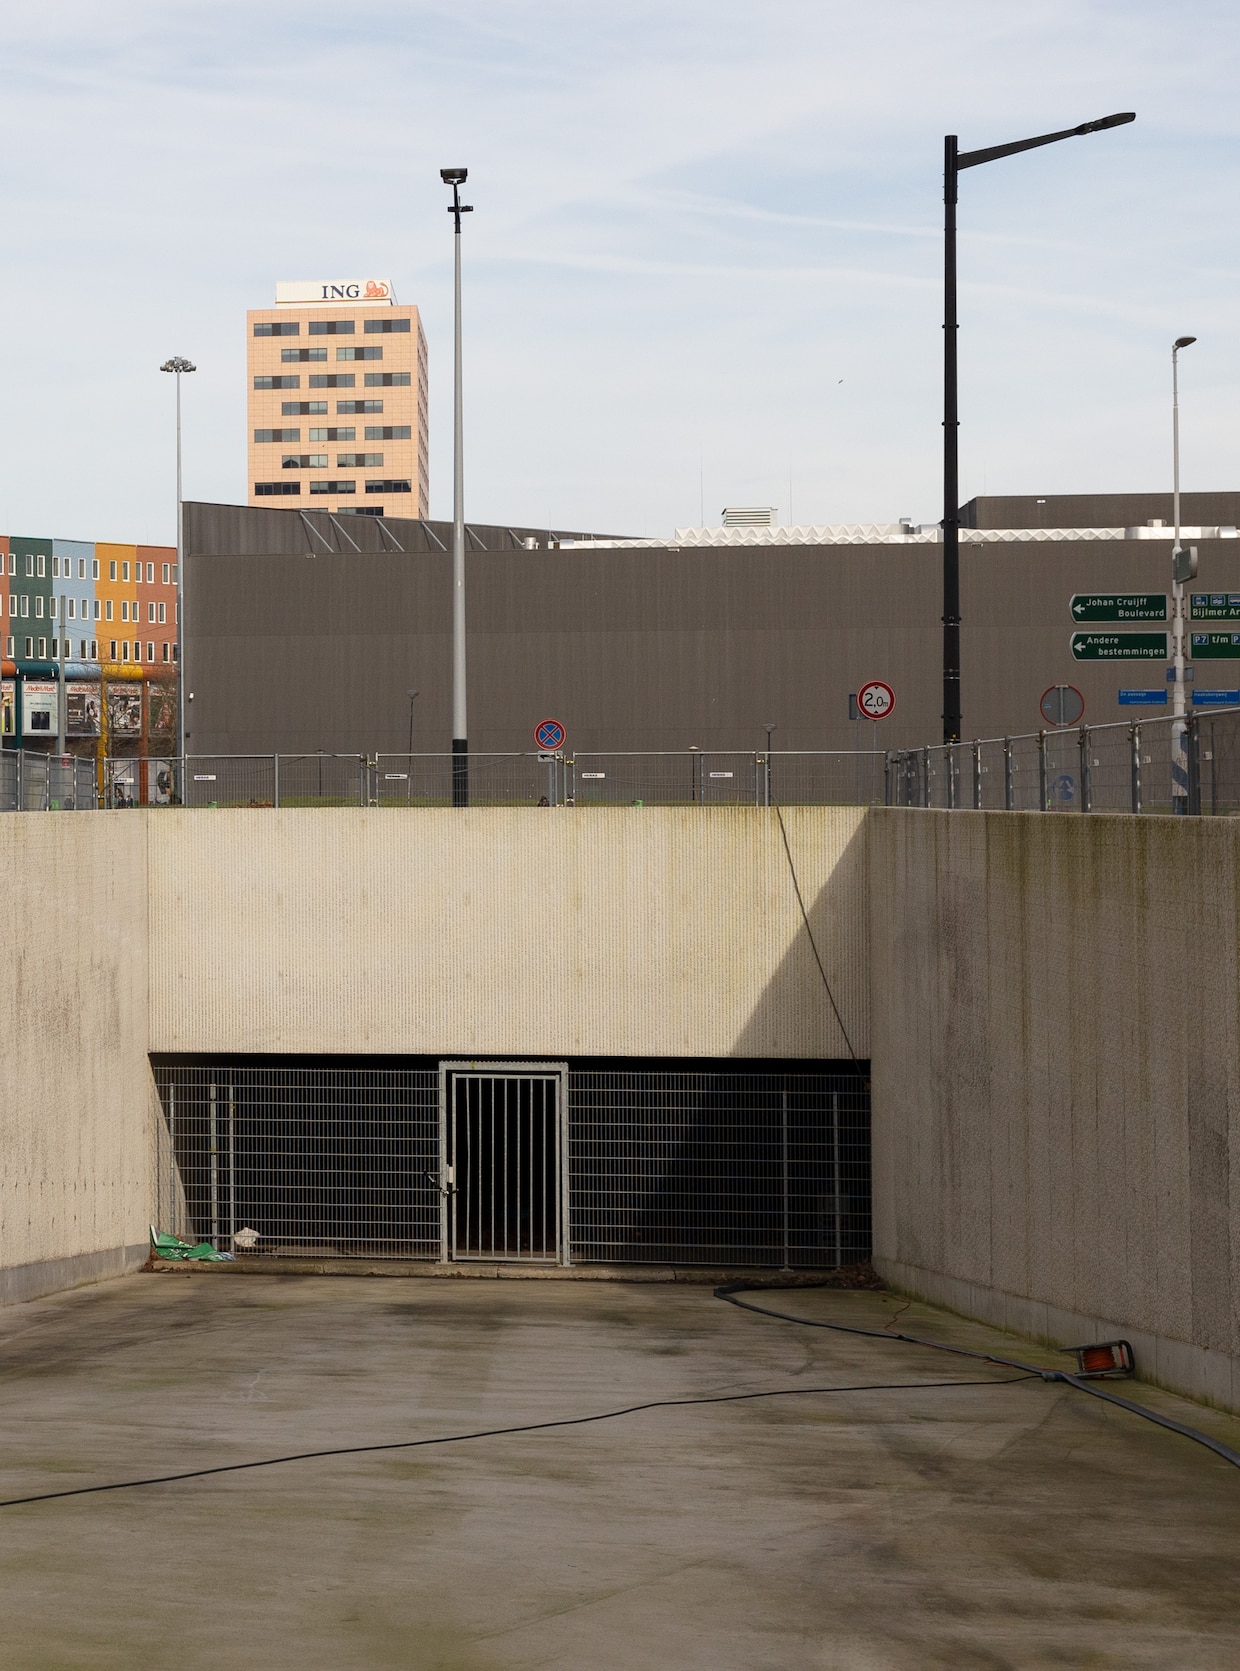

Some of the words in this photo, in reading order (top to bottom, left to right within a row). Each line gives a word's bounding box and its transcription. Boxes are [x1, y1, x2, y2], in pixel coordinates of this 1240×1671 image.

[322, 285, 360, 298] ING
[1117, 598, 1147, 608] Cruijff
[1118, 609, 1165, 617] Boulevard
[1192, 608, 1227, 618] Bijlmer
[1098, 648, 1165, 657] bestemmingen
